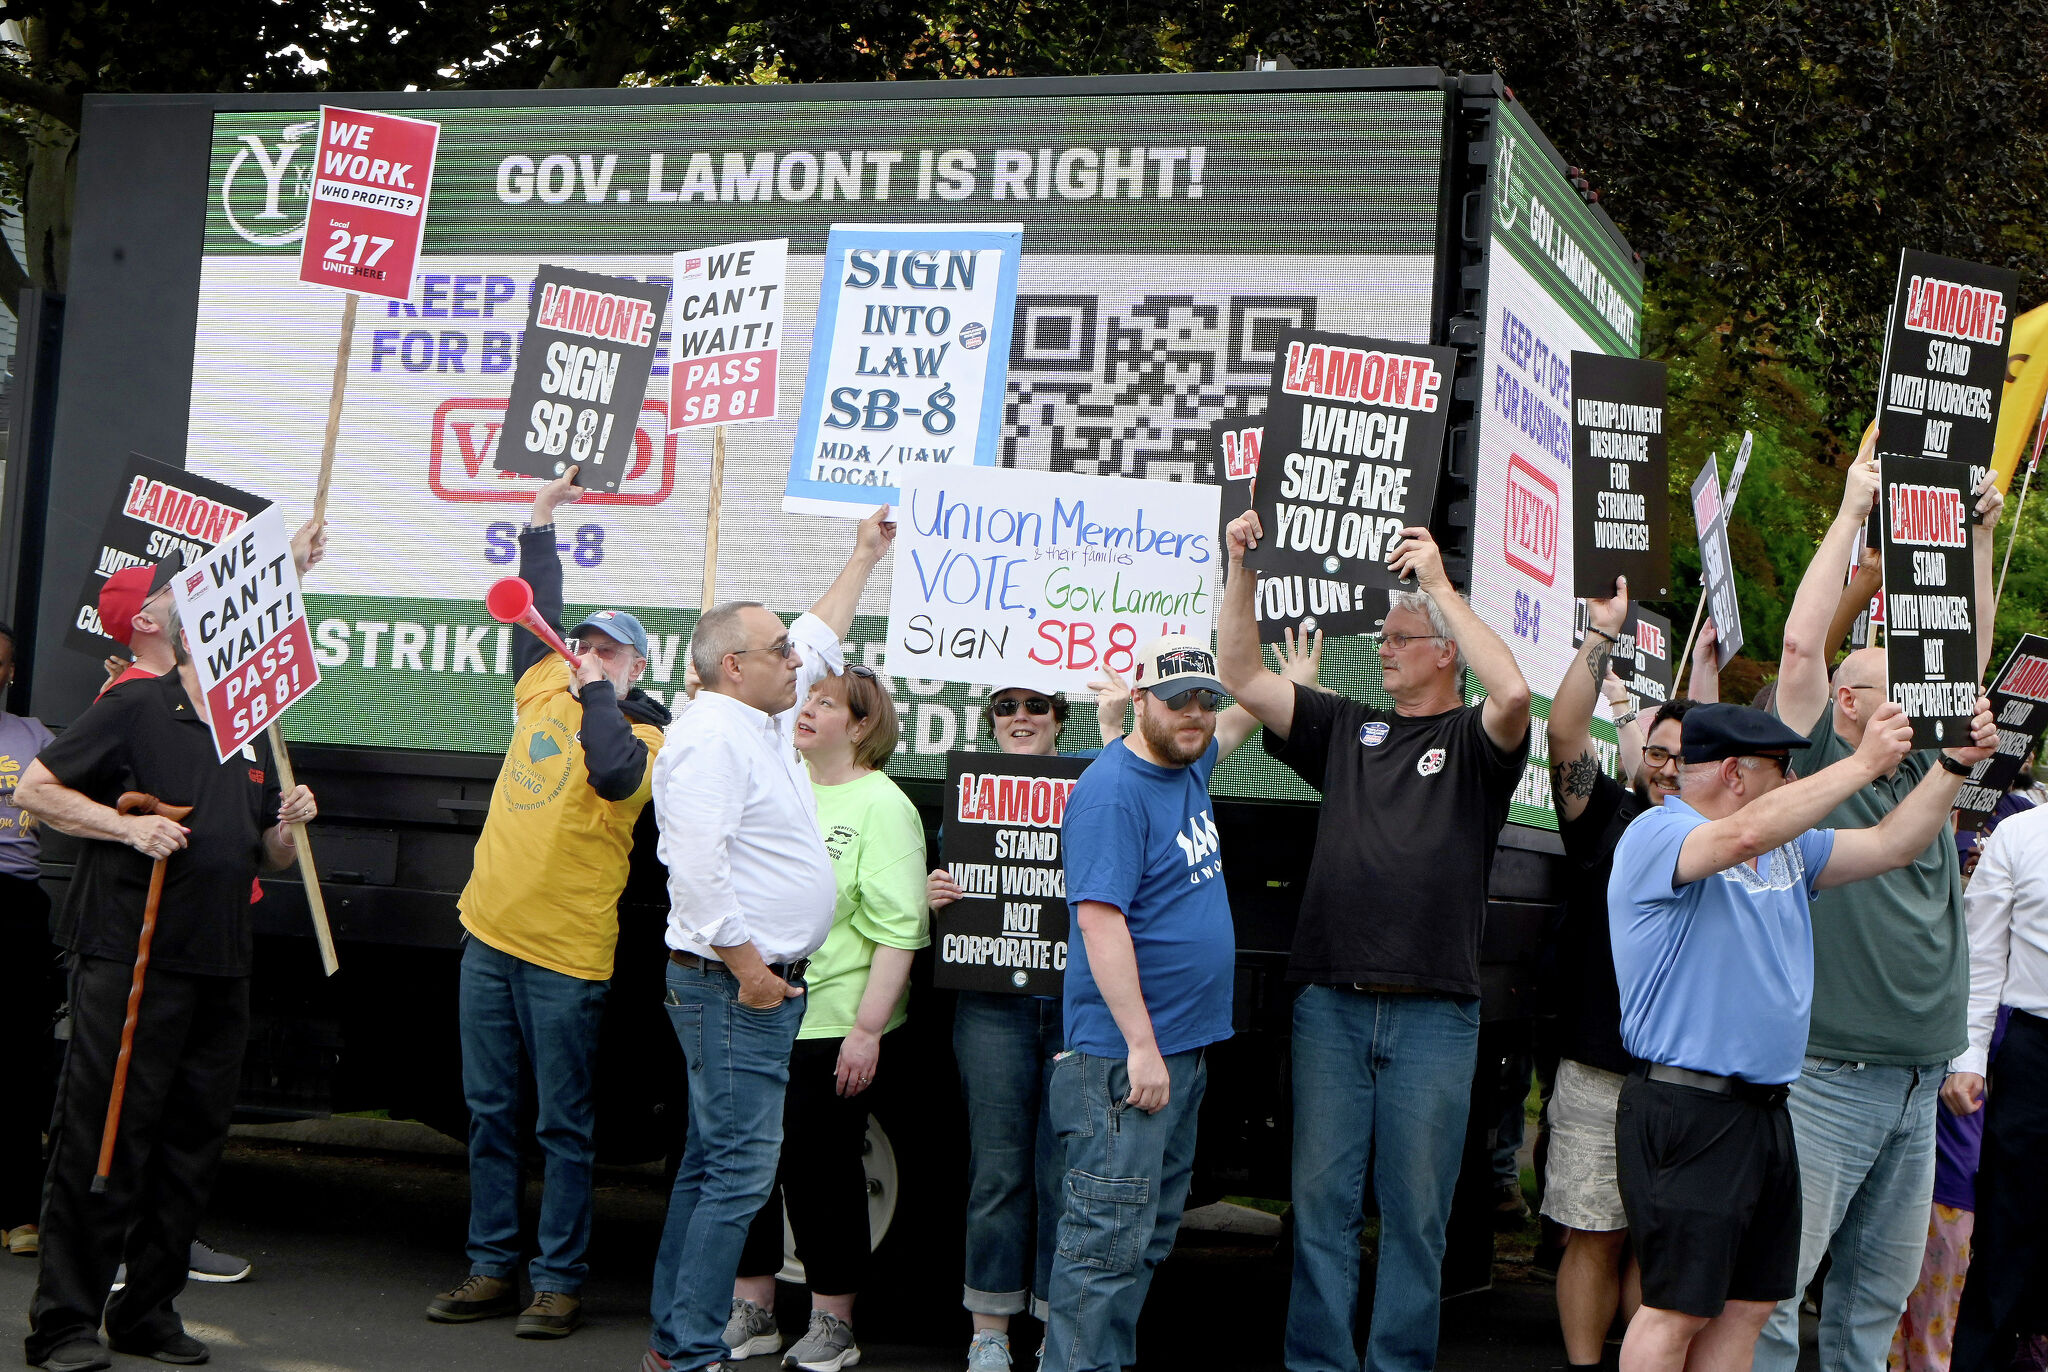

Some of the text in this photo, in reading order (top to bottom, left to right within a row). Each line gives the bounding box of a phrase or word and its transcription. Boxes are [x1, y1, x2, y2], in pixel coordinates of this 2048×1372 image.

[330, 120, 374, 150] WE
[324, 150, 415, 189] WORK.
[496, 146, 1206, 204] GOV. LAMONT IS RIGHT!
[321, 184, 414, 211] WHO PROFITS?
[330, 218, 350, 229] Local
[323, 229, 394, 267] 217
[708, 250, 755, 280] WE
[845, 250, 981, 291] SIGN
[1530, 196, 1634, 347] GOV. LAMONT IS RIGHT!
[538, 284, 655, 346] LAMONT:
[682, 285, 777, 322] CAN'T
[862, 305, 951, 337] INTO
[1906, 277, 2005, 345] LAMONT:
[371, 330, 469, 373] FOR
[682, 322, 774, 358] WAIT!
[855, 341, 952, 378] LAW
[1501, 306, 1570, 409] KEEP CT OPE
[1927, 340, 1971, 376] STAND
[541, 341, 621, 405] SIGN
[685, 357, 762, 390] PASS
[1283, 342, 1440, 411] LAMONT:
[683, 389, 757, 422] SB 8!
[824, 382, 957, 436] SB-8
[1495, 365, 1519, 427] FOR
[1889, 373, 1992, 423] WITH WORKERS,
[1301, 404, 1408, 461] WHICH
[1577, 399, 1663, 434] UNEMPLOYMENT
[1923, 419, 1952, 452] NOT
[817, 442, 870, 462] MDA
[899, 446, 955, 464] UAW
[1590, 431, 1649, 462] INSURANCE
[817, 465, 893, 487] LOCAL
[1280, 453, 1350, 505] SIDE
[1349, 463, 1411, 514] ARE
[1610, 463, 1629, 490] FOR
[125, 477, 246, 544] LAMONT
[1510, 481, 1555, 562] VETO
[1597, 491, 1645, 521] STRIKING
[1890, 483, 1966, 547] LAMONT:
[484, 521, 605, 568] S-8
[912, 488, 1210, 564] Union Members
[1275, 503, 1404, 562] YOU ON?
[1594, 521, 1649, 551] WORKERS!
[210, 531, 256, 589] WE
[1046, 546, 1079, 560] their
[1083, 545, 1133, 567] families
[1912, 551, 1946, 587] STAND
[200, 553, 286, 644] CAN'T
[911, 549, 1209, 620] VOTE, Gov. Lamont
[1514, 589, 1541, 644] SB-8
[1890, 594, 1919, 629] WITH
[1919, 595, 1971, 633] WORKERS,
[208, 592, 294, 682] WAIT!
[904, 614, 1009, 660] SIGN
[1924, 639, 1944, 674] NOT
[226, 633, 294, 710] PASS
[233, 664, 300, 740] SB 8!
[1893, 683, 1952, 717] CORPORATE
[1997, 700, 2034, 726] STAND
[1996, 729, 2033, 760] ORKERS,
[959, 774, 1078, 827] LAMON
[995, 829, 1057, 861] STAND
[948, 862, 998, 893] WITH
[1003, 902, 1042, 933] NOT
[942, 933, 1051, 970] CORPORATE
